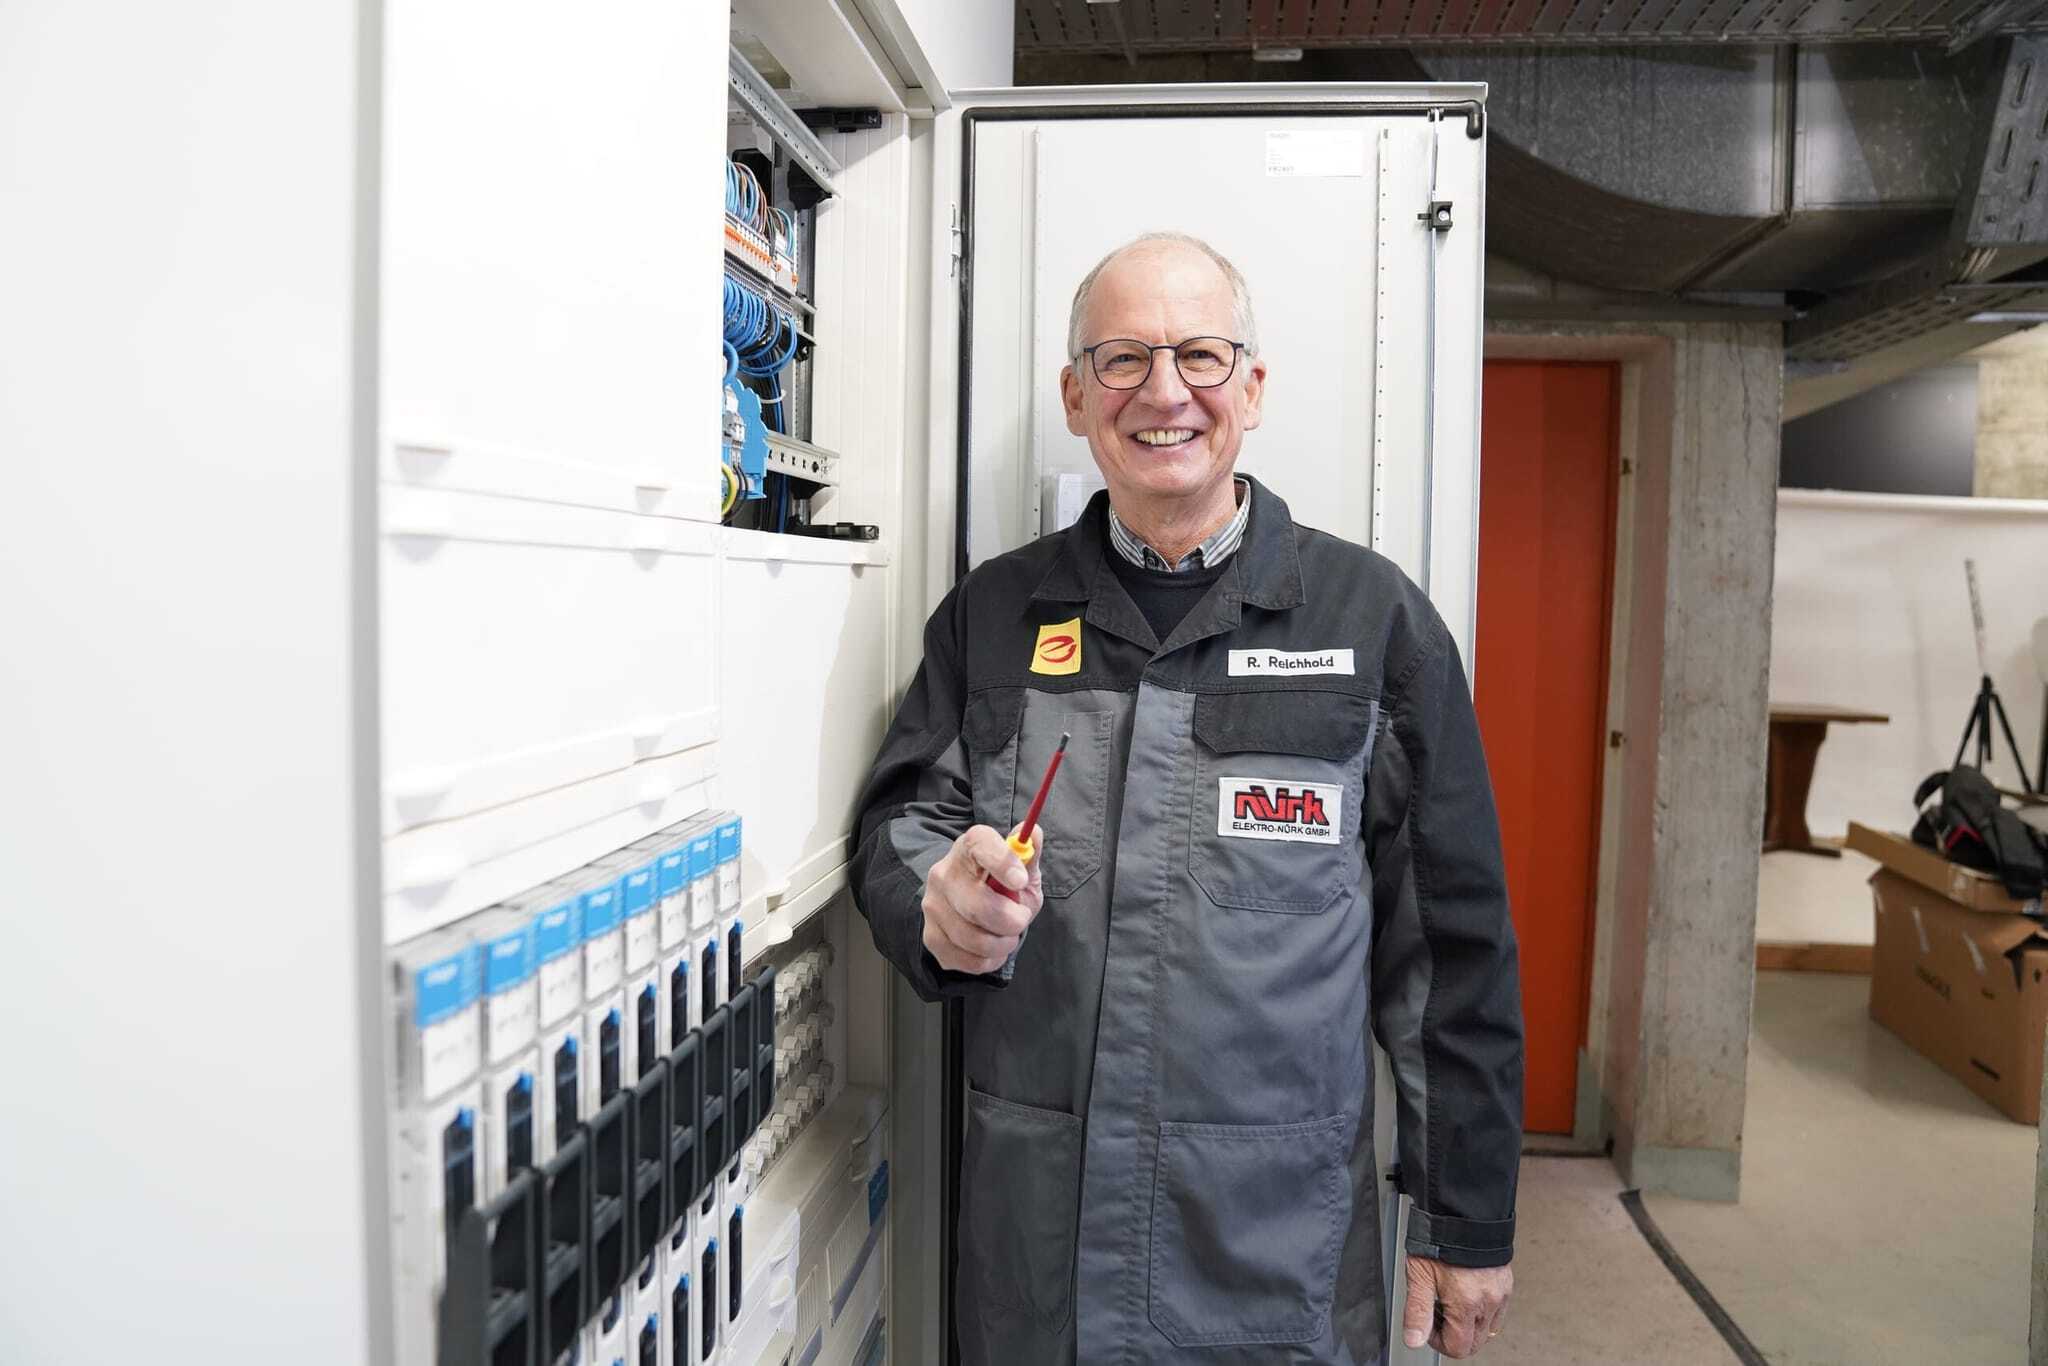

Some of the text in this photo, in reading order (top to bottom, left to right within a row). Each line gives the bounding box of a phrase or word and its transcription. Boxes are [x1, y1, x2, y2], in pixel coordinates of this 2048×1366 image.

[1247, 656, 1334, 669] R. Reichhold
[1232, 822, 1330, 837] ELEKTRO-NÜRK GMBH
